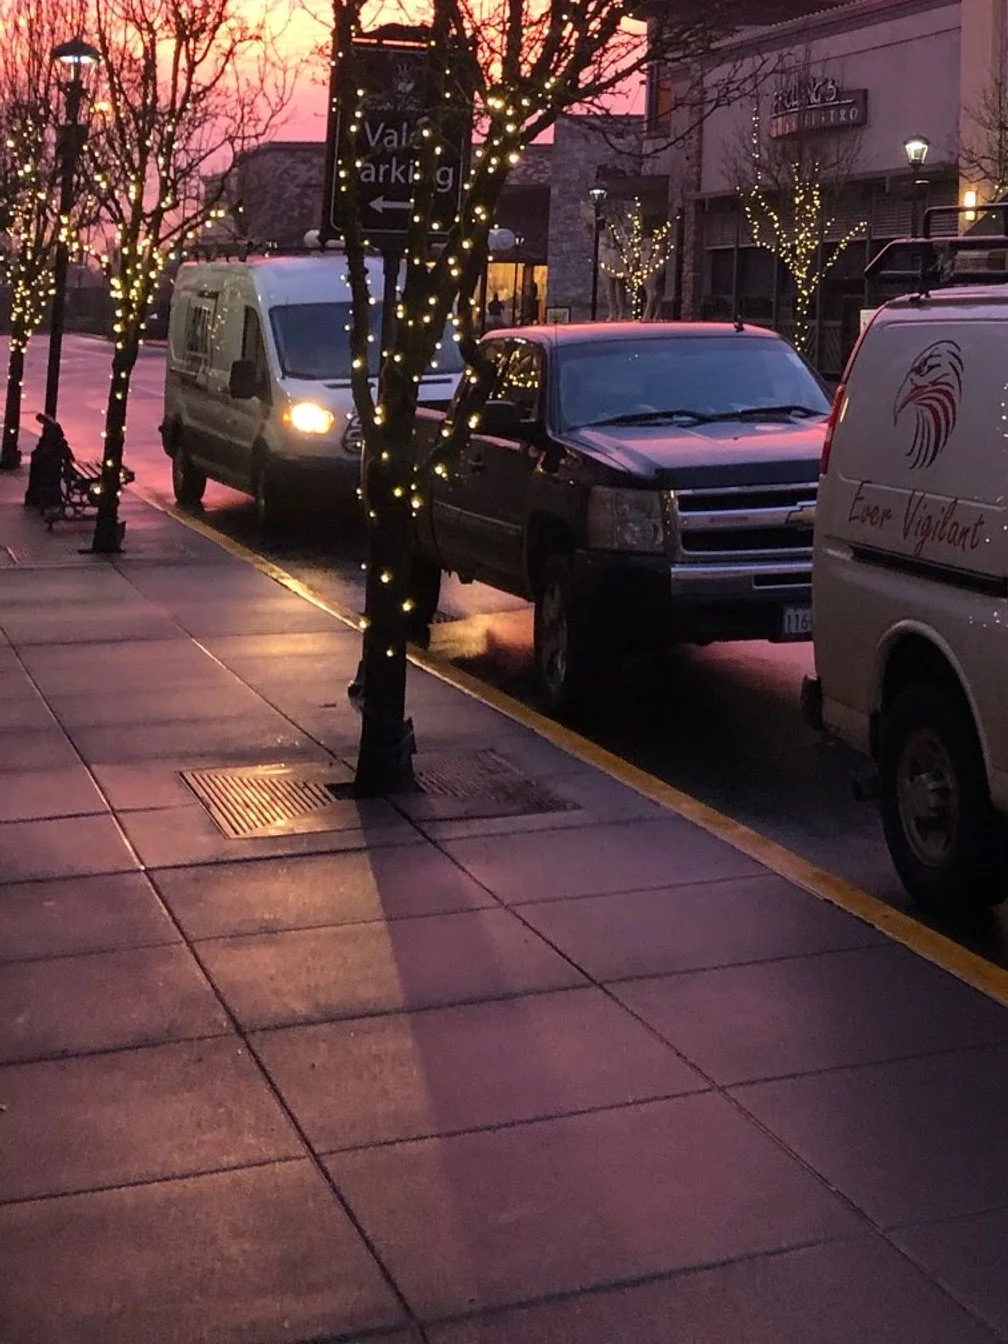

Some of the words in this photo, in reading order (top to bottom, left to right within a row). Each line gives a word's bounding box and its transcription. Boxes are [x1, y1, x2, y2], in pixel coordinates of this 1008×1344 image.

[360, 155, 455, 193] arkig
[848, 480, 893, 530] Ever
[902, 488, 986, 557] Vigilant
